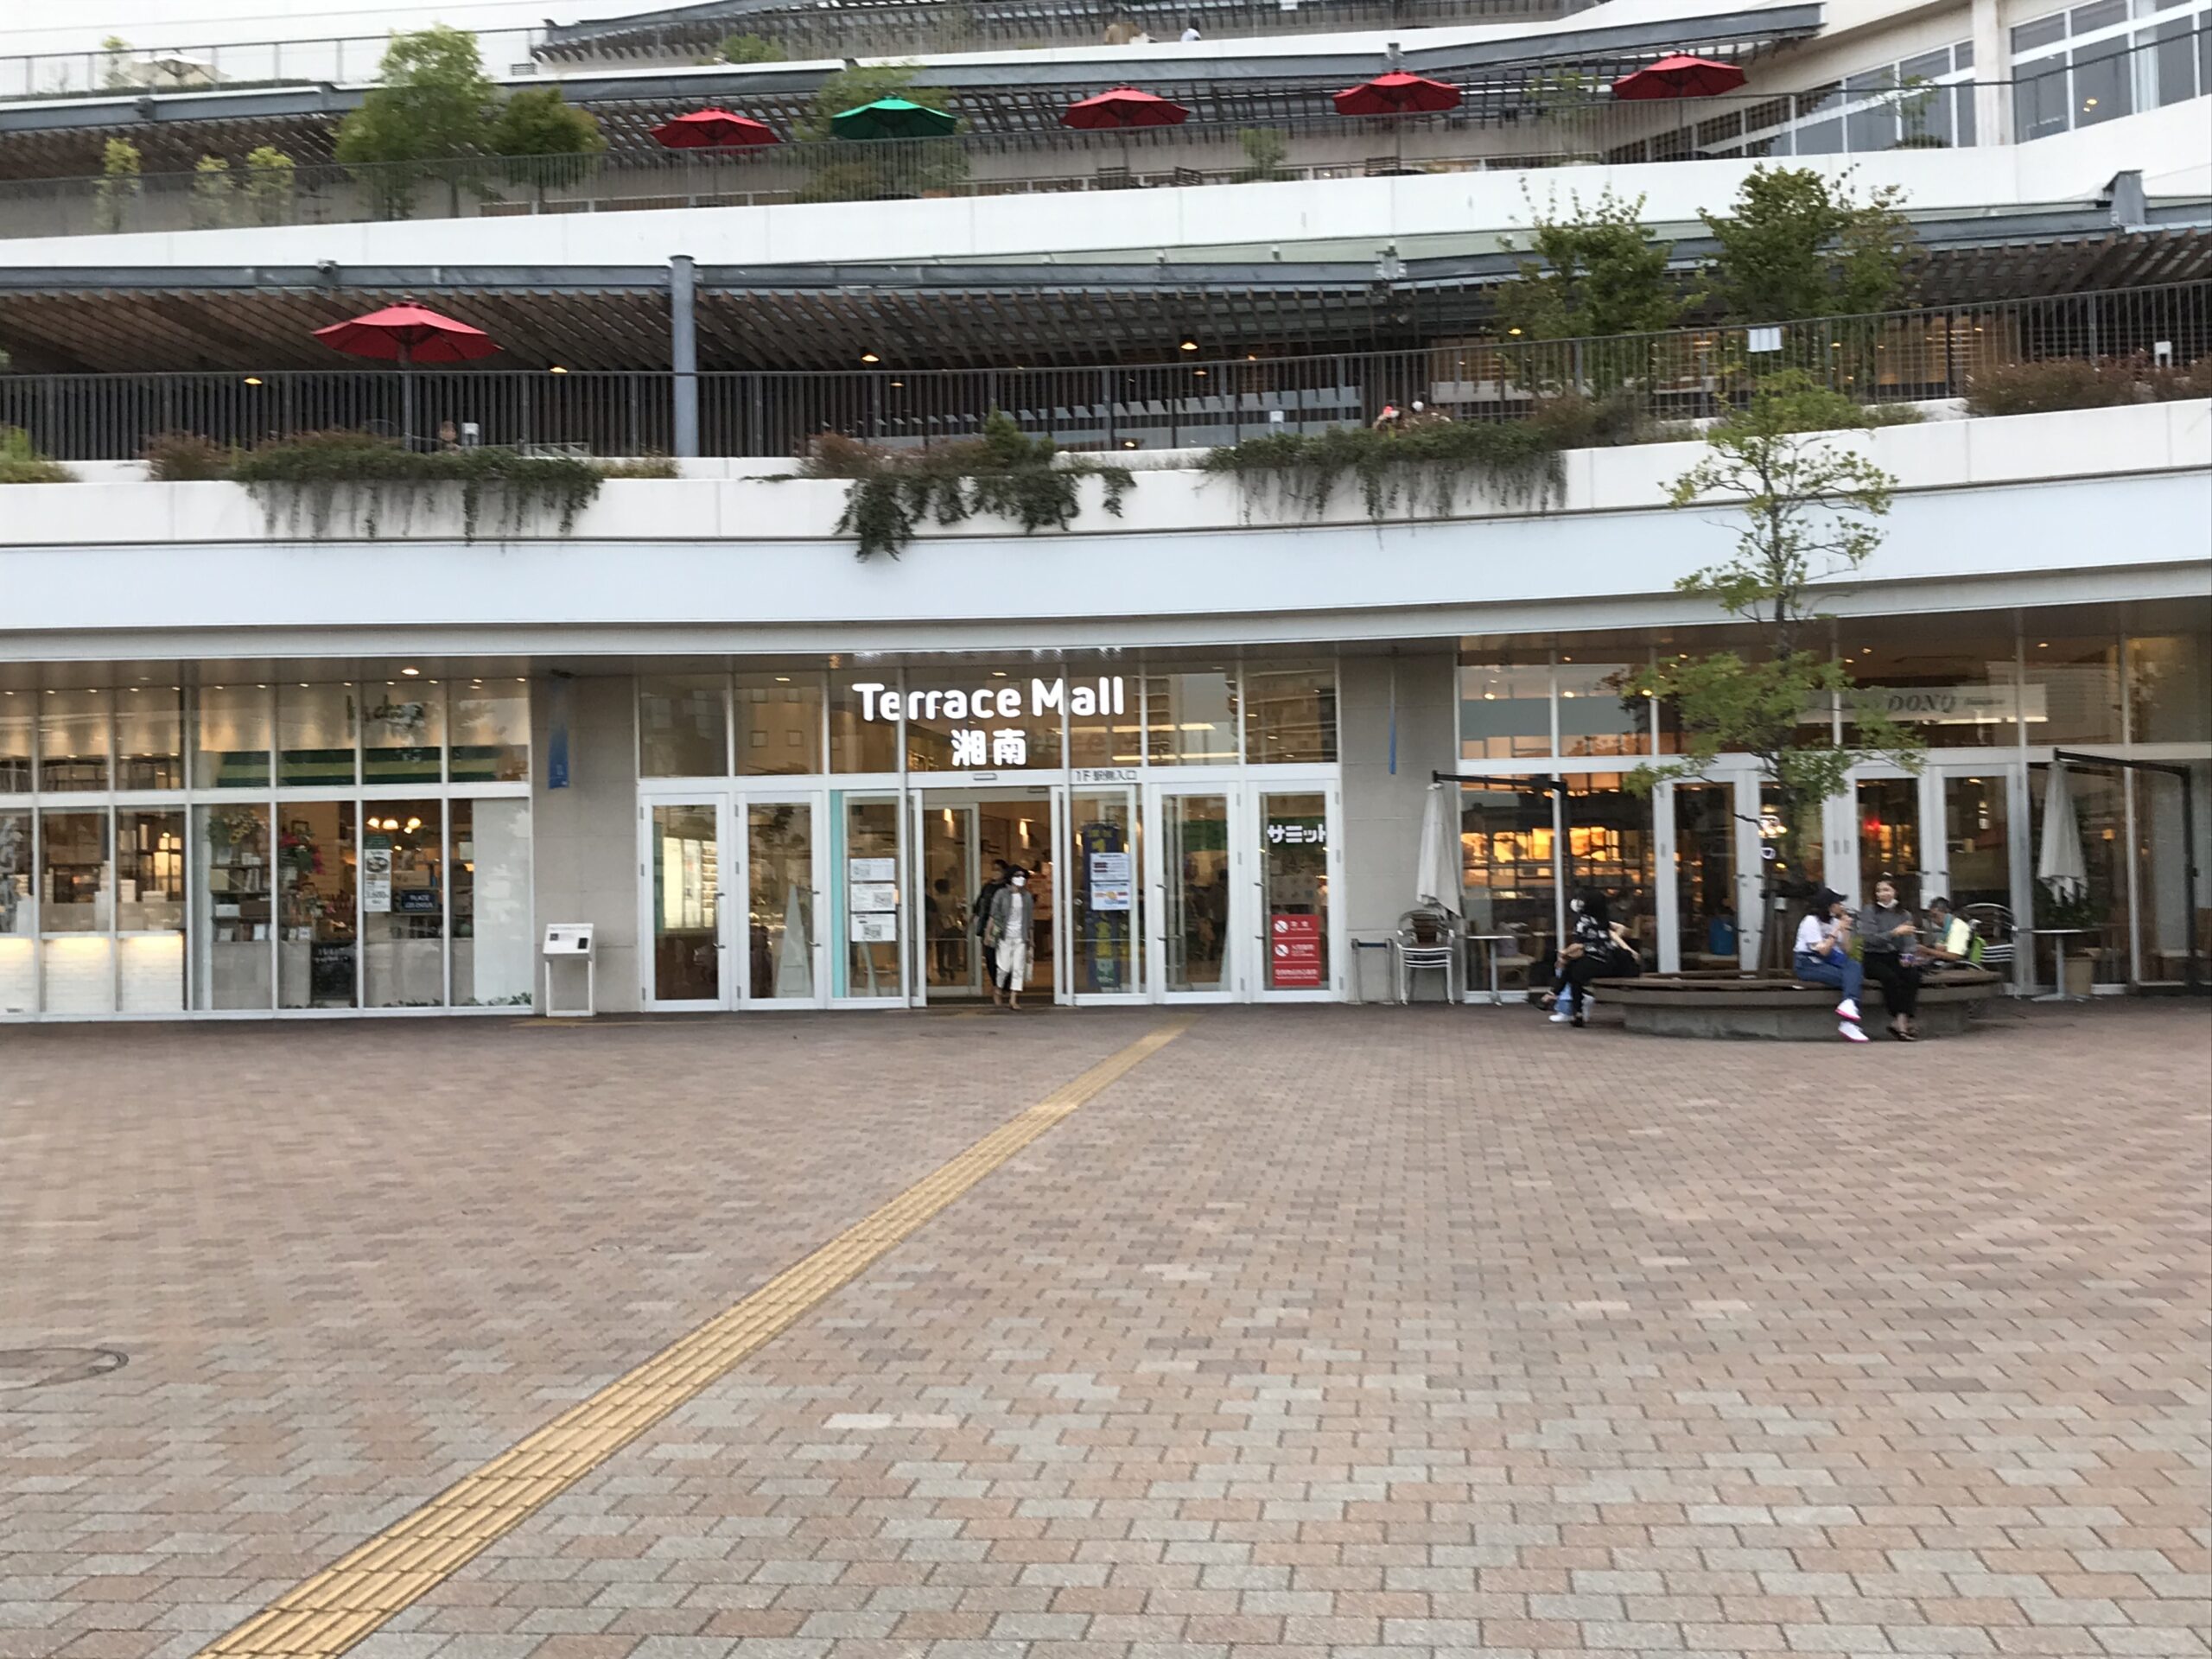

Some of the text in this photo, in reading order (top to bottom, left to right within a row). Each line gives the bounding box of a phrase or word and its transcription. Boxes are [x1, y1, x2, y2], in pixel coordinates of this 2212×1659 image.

[851, 676, 1124, 722] Terrace Mall
[950, 728, 1027, 767] 湘南
[1267, 823, 1326, 843] サミット
